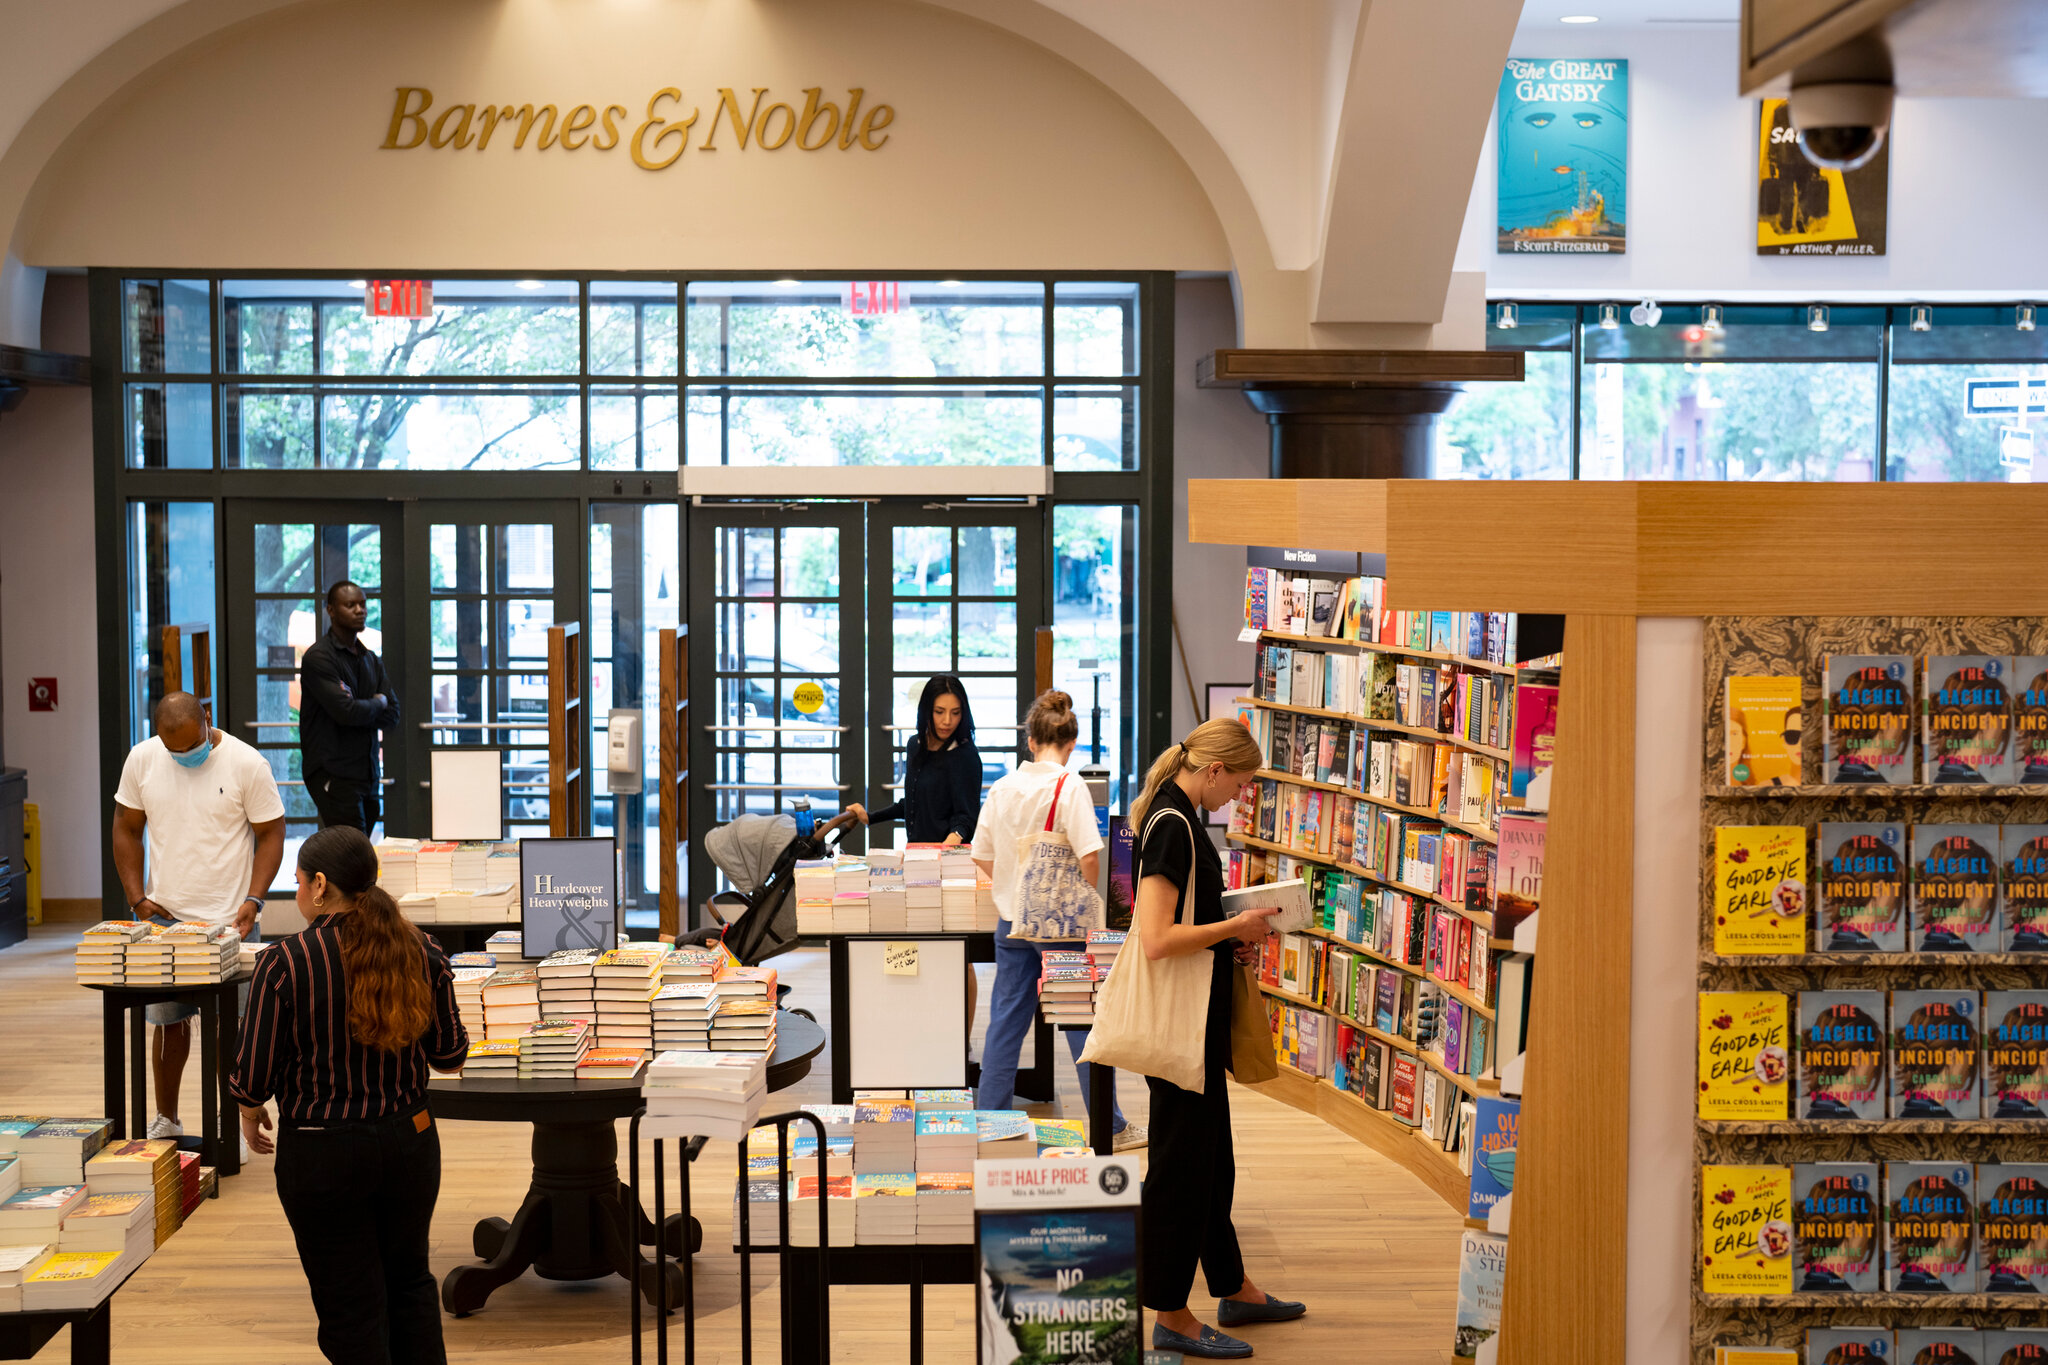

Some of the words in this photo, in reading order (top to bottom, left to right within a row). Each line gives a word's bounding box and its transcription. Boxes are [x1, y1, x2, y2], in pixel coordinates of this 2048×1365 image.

[1506, 59, 1546, 80] The
[1550, 60, 1617, 81] GREAT
[1515, 82, 1605, 102] GATSBY
[379, 87, 627, 151] Barnes
[630, 87, 699, 171] &
[699, 87, 895, 151] Noble
[1553, 241, 1610, 252] FITZGERALD
[1792, 245, 1833, 255] ARTHUR
[1835, 244, 1876, 255] MILLER
[1284, 550, 1297, 562] New
[1297, 550, 1317, 563] Fiction
[1859, 667, 1885, 680] THE
[1958, 667, 1984, 680] THE
[1839, 689, 1903, 705] RACHEL
[1939, 689, 2003, 705] RACHEL
[1834, 714, 1909, 730] INCIDENT
[1934, 714, 2009, 730] INCIDENT
[1471, 757, 1484, 767] THE
[1467, 796, 1481, 806] PAU
[1120, 828, 1134, 838] Ou
[1503, 830, 1535, 845] DIANA
[1851, 835, 1877, 848] THE
[1944, 836, 1970, 849] THE
[2033, 836, 2048, 849] TH
[1528, 856, 1543, 875] Th
[1832, 857, 1896, 873] RACHEL
[1925, 858, 1989, 874] RACHEL
[1726, 857, 1800, 890] GOODBYE
[534, 874, 603, 895] Hardcover
[1827, 882, 1902, 898] INCIDENT
[1920, 883, 1995, 899] INCIDENT
[529, 896, 609, 911] Heavyweights
[1727, 890, 1772, 914] EARL
[1831, 1004, 1857, 1017] THE
[1924, 1003, 1950, 1016] THE
[2018, 1003, 2044, 1016] THE
[1710, 1025, 1783, 1056] GOODBYE
[1811, 1026, 1875, 1042] RACHEL
[1905, 1025, 1969, 1041] RACHEL
[1806, 1051, 1881, 1067] INCIDENT
[1900, 1050, 1975, 1066] INCIDENT
[1399, 1063, 1411, 1072] JOYCE
[1711, 1057, 1754, 1080] EARL
[1395, 1102, 1408, 1112] HOTEL
[1498, 1113, 1520, 1132] OU
[1482, 1132, 1518, 1152] HOSP
[1015, 1168, 1048, 1186] HALF
[1052, 1167, 1089, 1185] PRICE
[1824, 1176, 1850, 1189] THE
[1919, 1176, 1945, 1189] THE
[2009, 1177, 2035, 1190] THE
[1472, 1191, 1505, 1206] SAMU
[1804, 1198, 1868, 1214] RACHEL
[1900, 1197, 1964, 1213] RACHEL
[1713, 1199, 1787, 1230] GOODBYE
[1030, 1228, 1047, 1236] OUR
[1049, 1226, 1087, 1235] MONTHLY
[1799, 1222, 1874, 1238] INCIDENT
[1895, 1222, 1970, 1238] INCIDENT
[1009, 1237, 1043, 1246] MYSTERY
[1052, 1235, 1087, 1244] THRILLER
[1089, 1234, 1107, 1242] PICK
[1714, 1231, 1758, 1254] EARL
[1466, 1240, 1505, 1258] DANI
[1479, 1257, 1505, 1273] STE
[1056, 1268, 1083, 1293] NO
[1477, 1285, 1502, 1298] Wed
[1013, 1297, 1127, 1326] STRANGERS
[1477, 1298, 1502, 1311] Plan
[1046, 1330, 1096, 1355] HERE
[1840, 1343, 1866, 1356] THE
[1929, 1343, 1955, 1356] THE
[2015, 1344, 2041, 1357] THE
